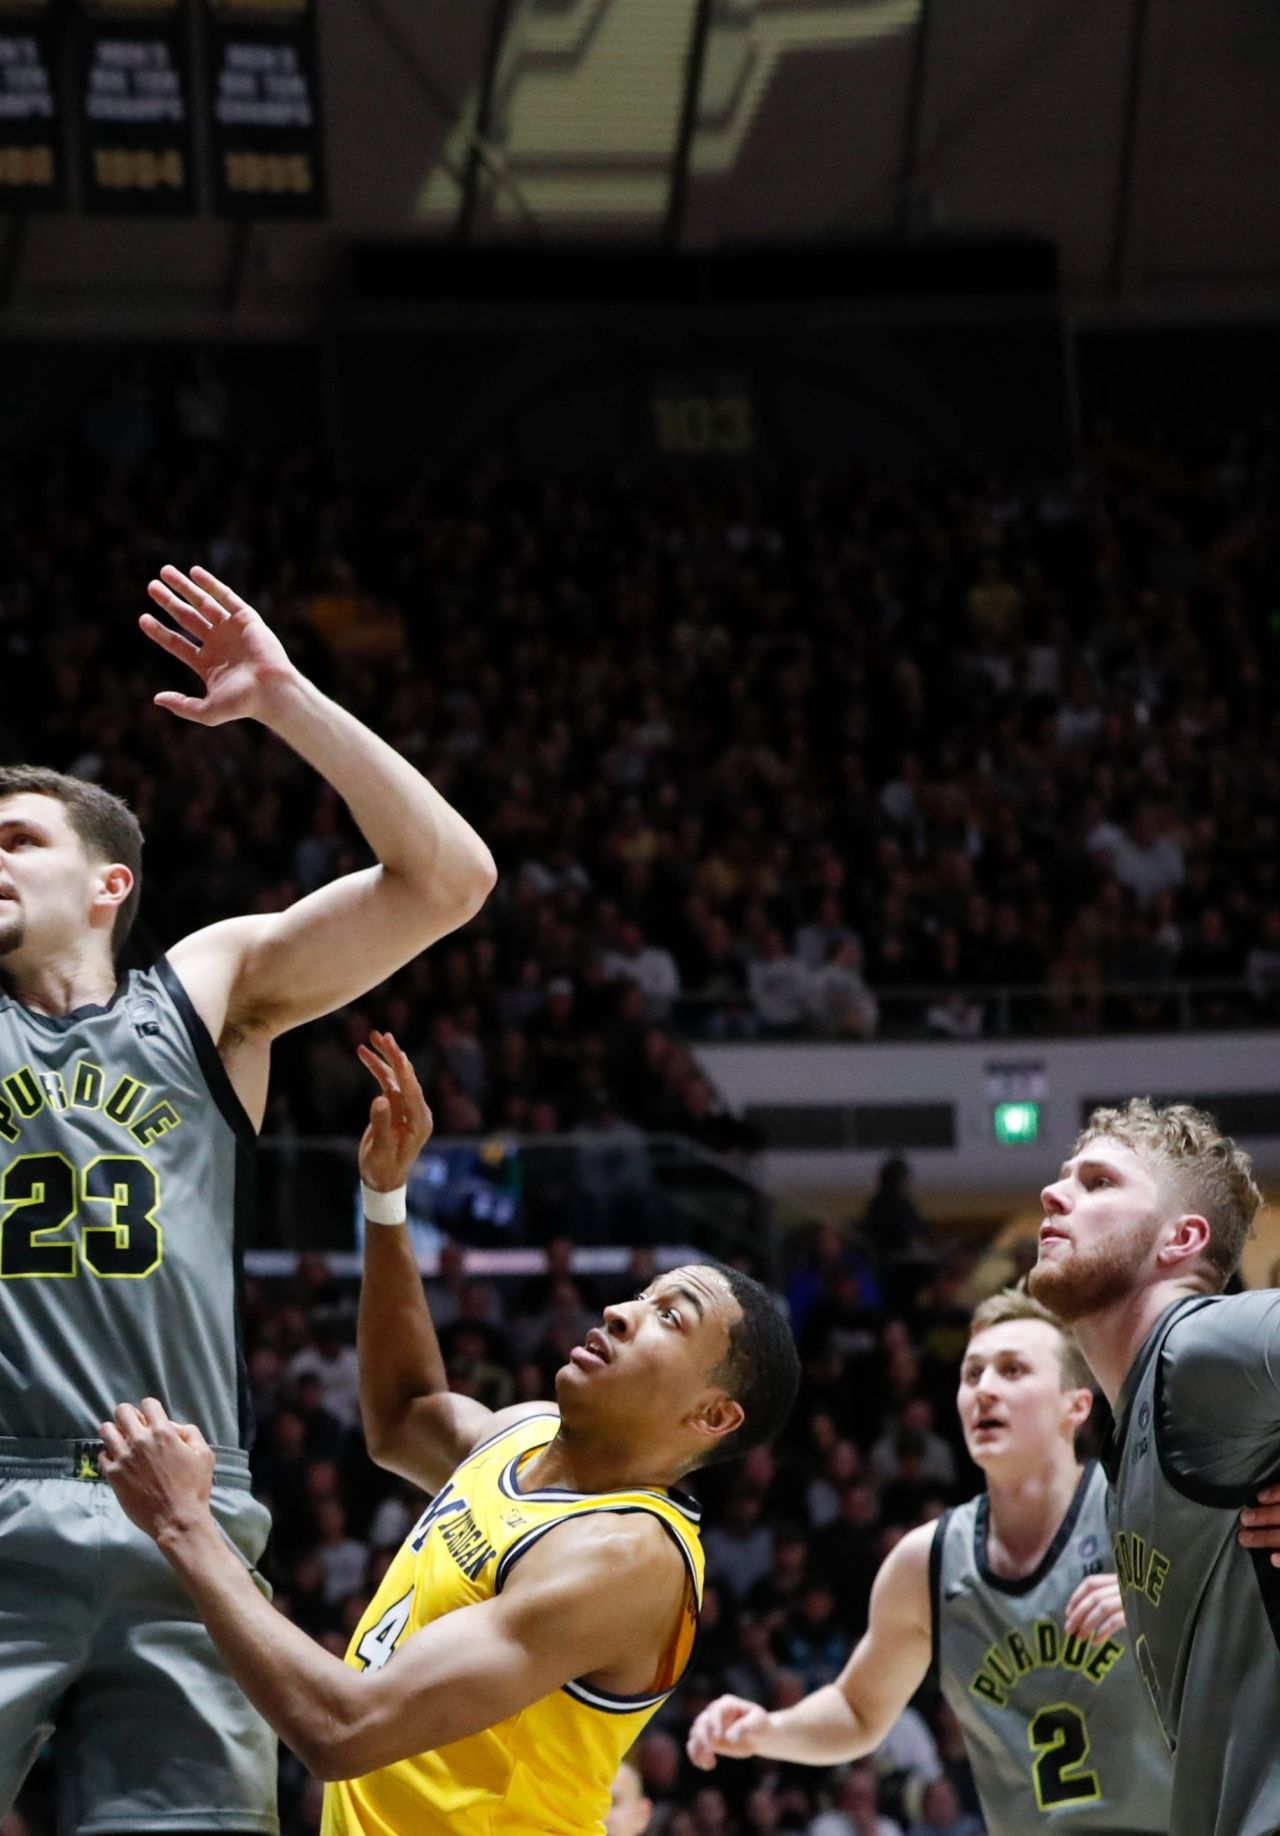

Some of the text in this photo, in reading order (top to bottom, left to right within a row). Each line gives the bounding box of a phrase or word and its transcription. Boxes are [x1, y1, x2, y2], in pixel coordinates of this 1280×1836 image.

[356, 1584, 415, 1673] 4
[969, 1620, 1125, 1709] PURDUE
[1028, 1702, 1102, 1813] 2
